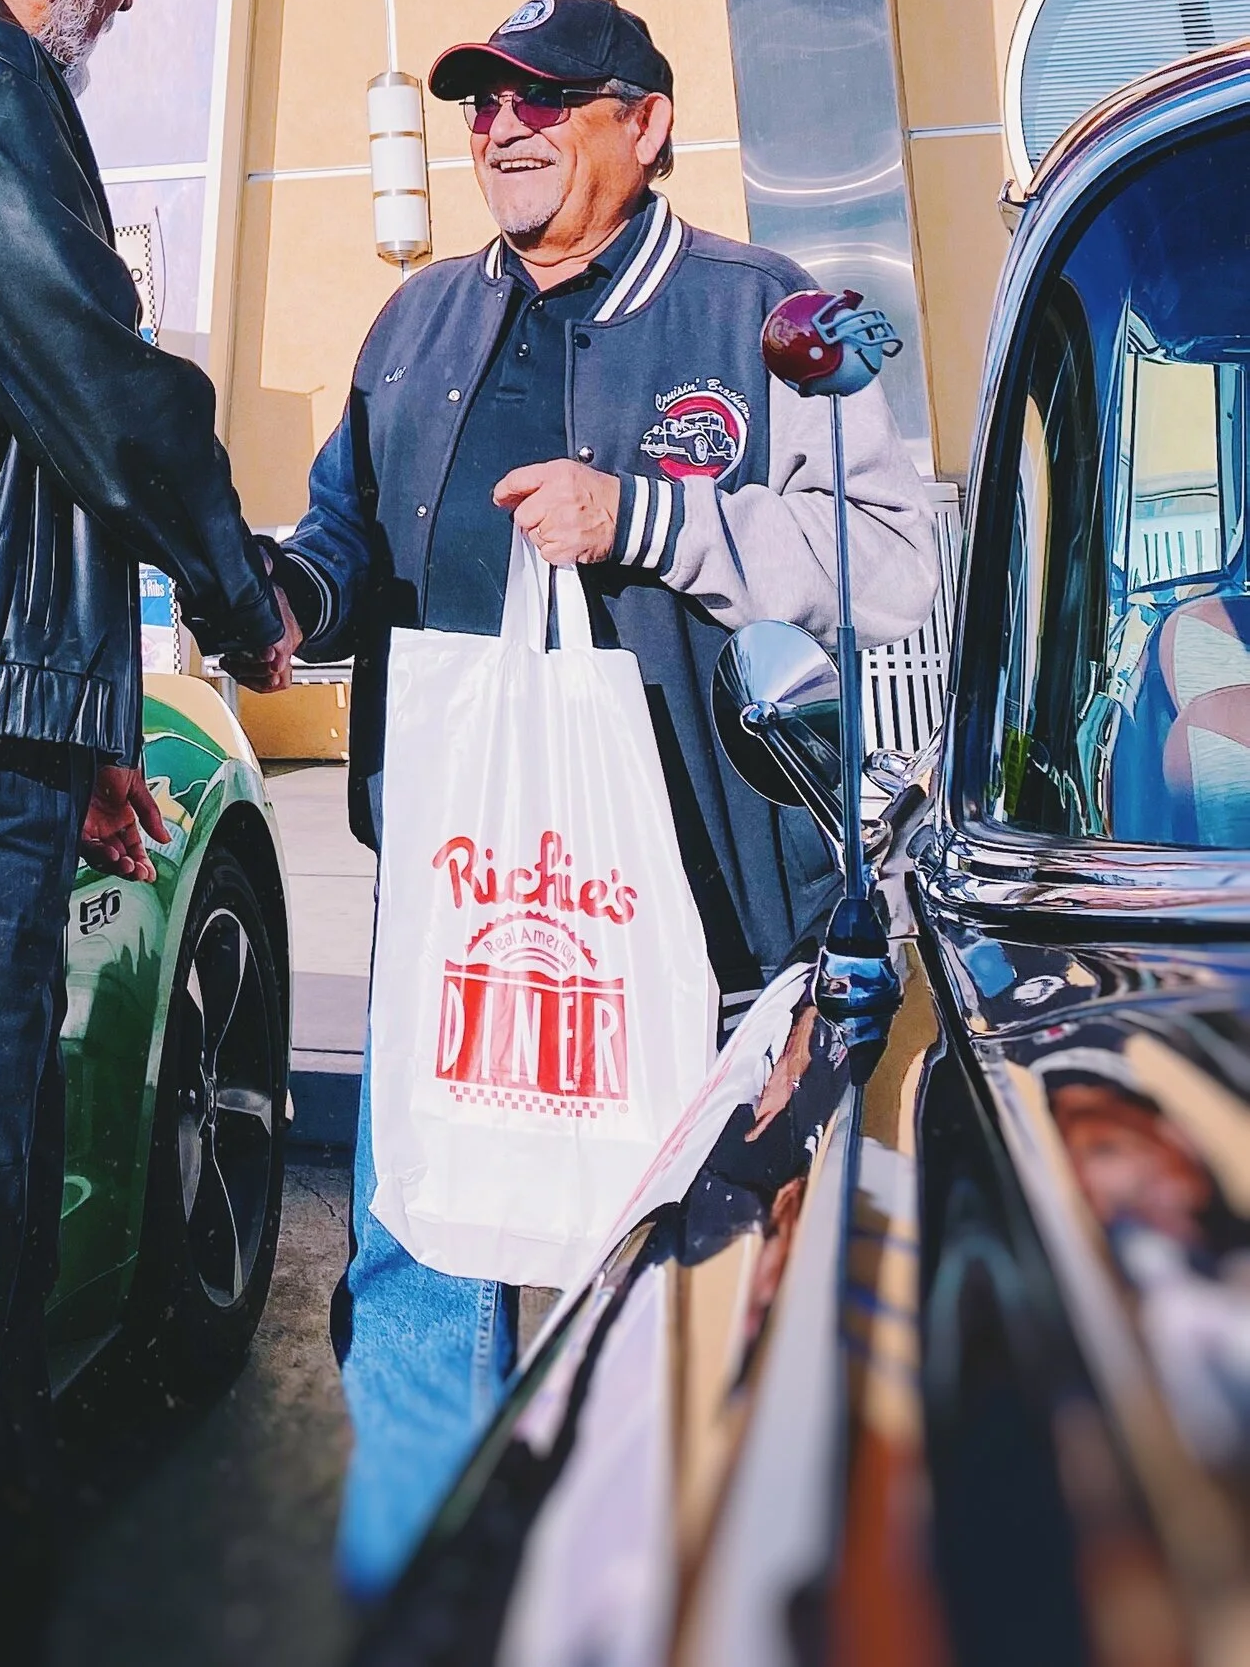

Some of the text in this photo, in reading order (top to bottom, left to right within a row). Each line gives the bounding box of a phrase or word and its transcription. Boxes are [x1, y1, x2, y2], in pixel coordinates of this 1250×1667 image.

[655, 378, 700, 411] Cruisin'
[432, 830, 638, 925] Richie's
[483, 925, 577, 969] Real American
[440, 980, 620, 1094] DINER
